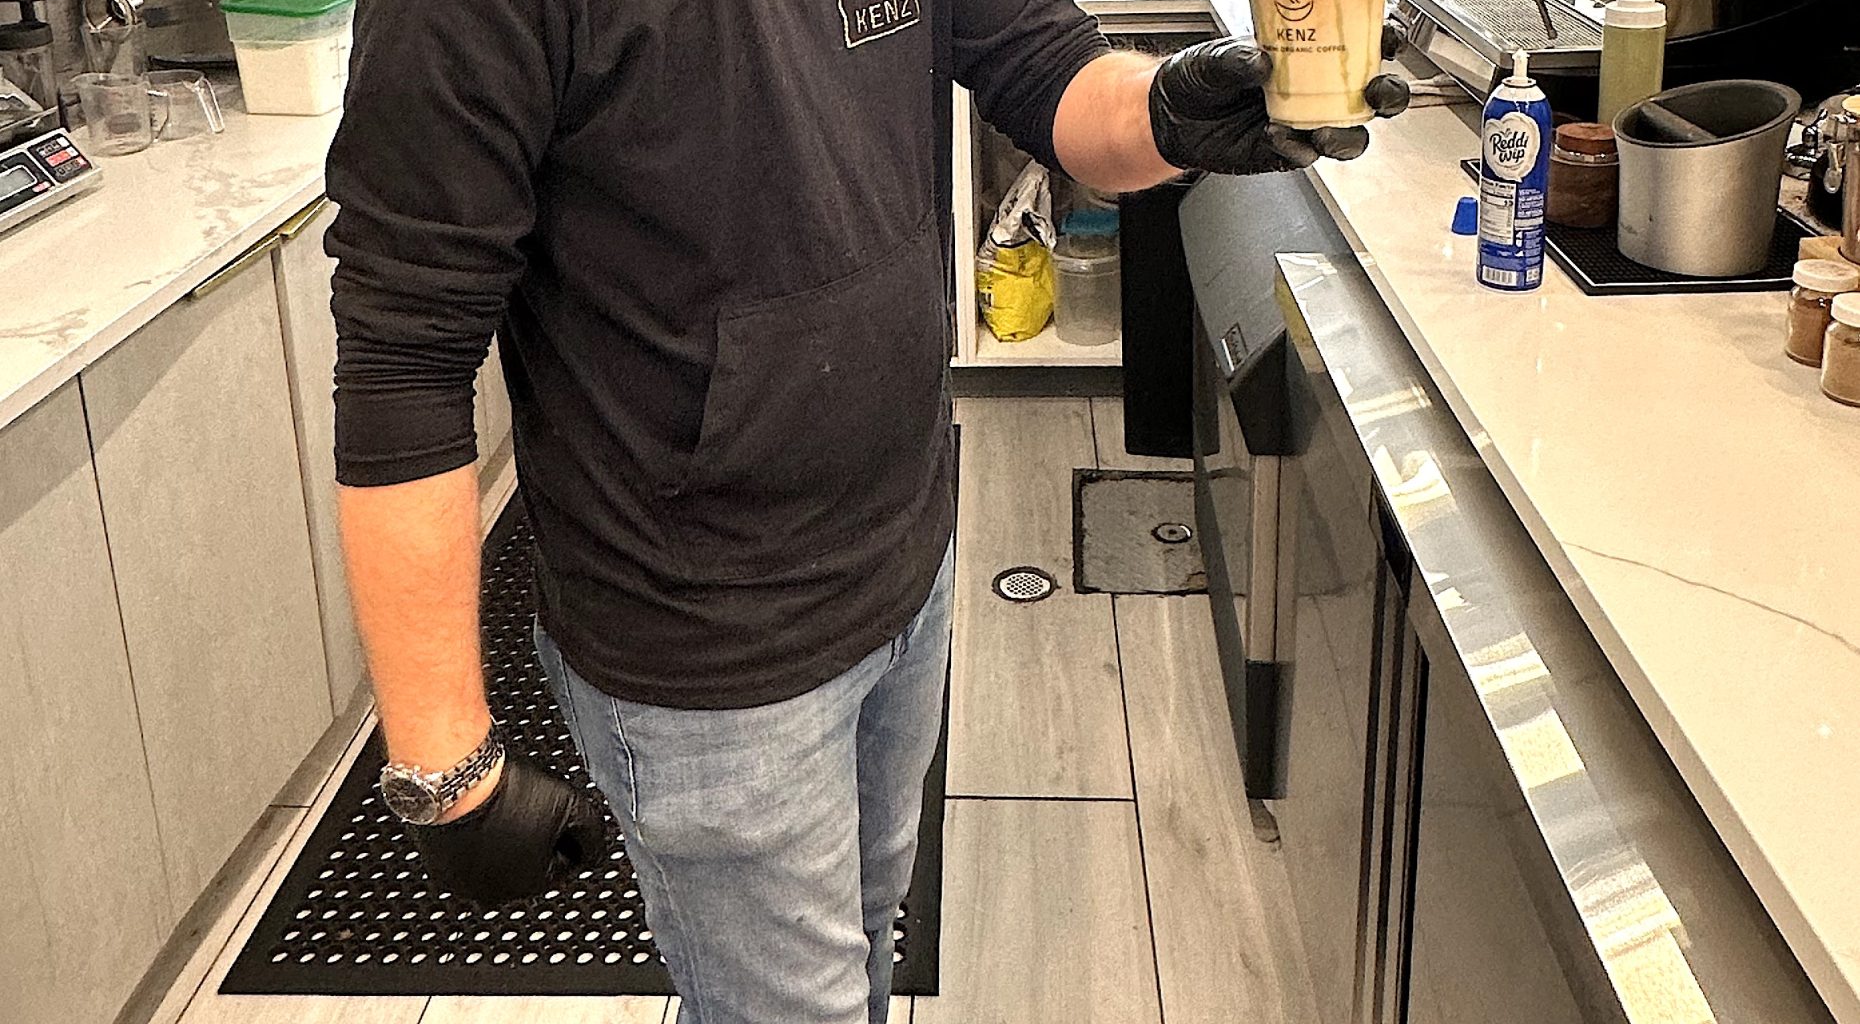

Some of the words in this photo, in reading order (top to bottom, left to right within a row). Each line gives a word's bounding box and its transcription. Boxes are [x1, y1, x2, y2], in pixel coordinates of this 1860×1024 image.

[1276, 28, 1317, 42] KENZ
[1316, 44, 1346, 53] COFFEE
[1489, 131, 1529, 155] Reddi
[1499, 148, 1525, 163] wip
